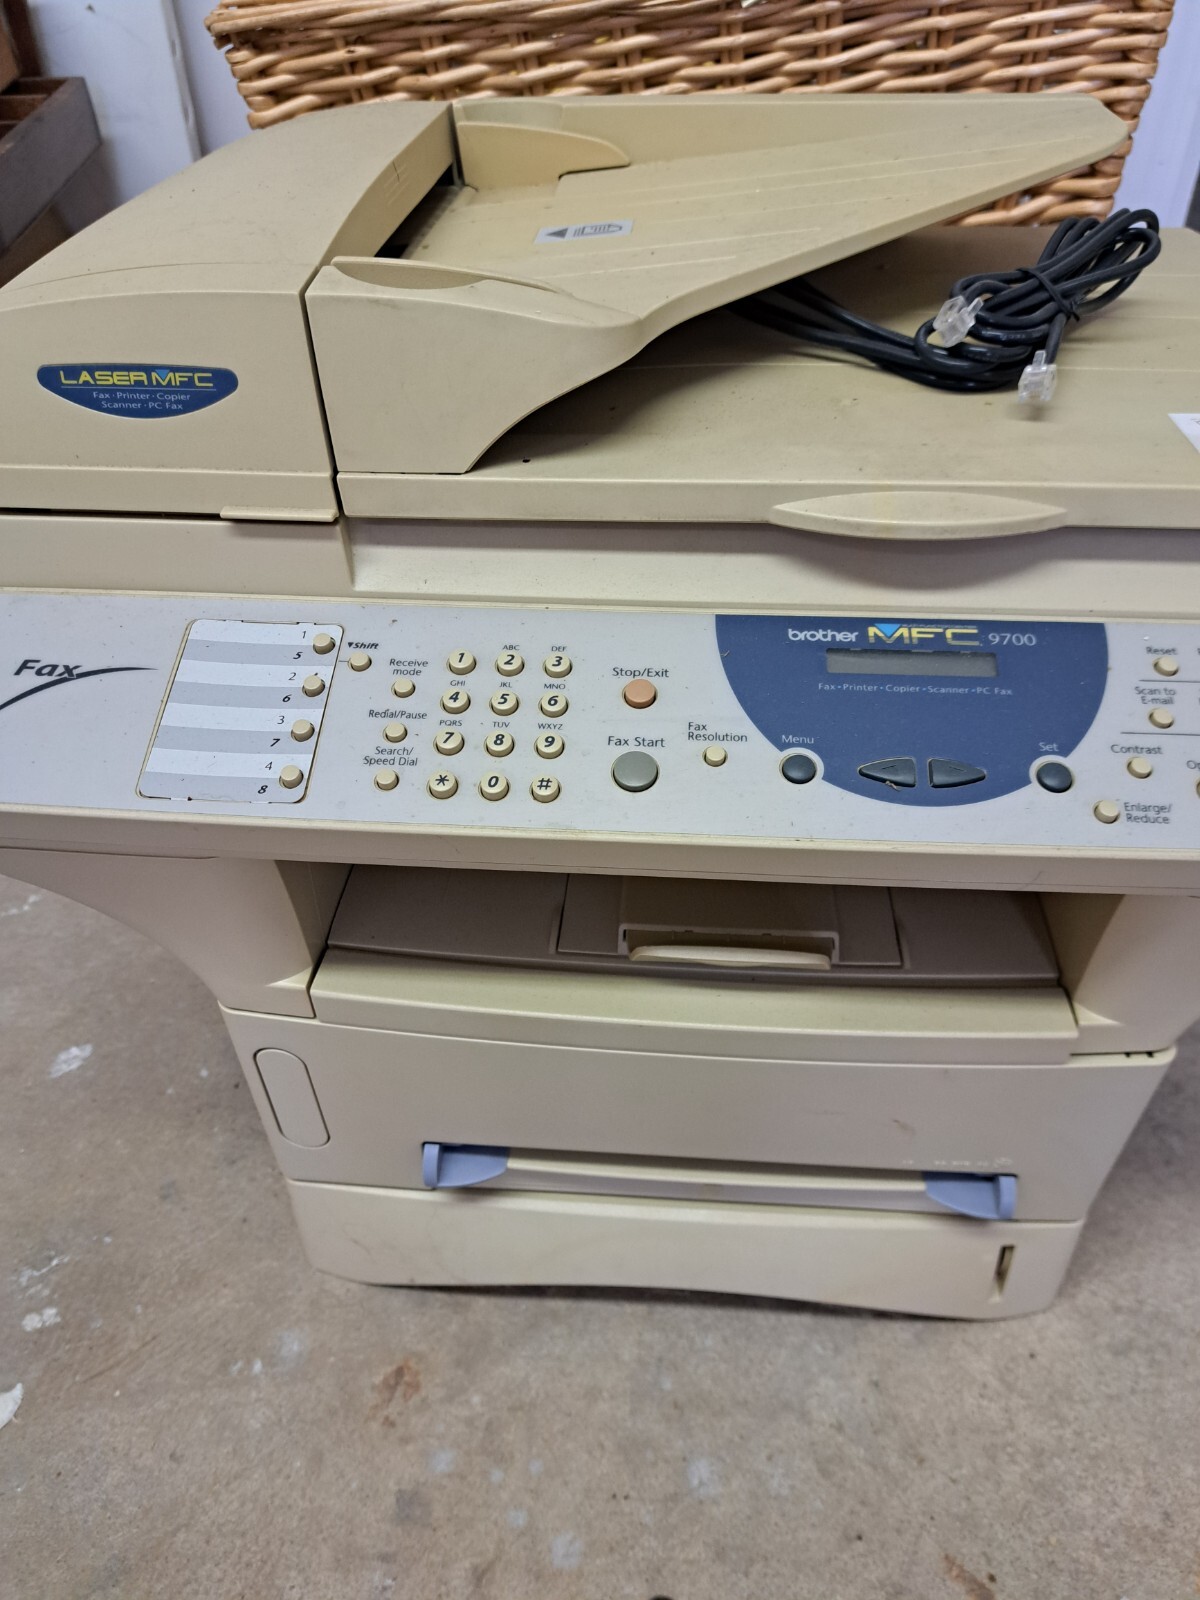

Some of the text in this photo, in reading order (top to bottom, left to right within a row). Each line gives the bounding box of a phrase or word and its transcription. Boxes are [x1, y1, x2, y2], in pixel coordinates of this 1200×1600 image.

[60, 370, 213, 387] LASER MFC
[93, 391, 191, 402] Fax Printer Copier
[101, 401, 183, 410] Scanner PC Fax
[302, 631, 307, 639] 1
[788, 624, 1037, 647] brother MFC 9700
[353, 641, 379, 650] Shift
[1145, 646, 1178, 656] Reset
[293, 651, 302, 660] 5
[456, 652, 465, 663] 1
[503, 654, 515, 665] 2
[389, 658, 429, 668] Receive
[551, 656, 563, 667] 3
[13, 658, 83, 679] Fax
[392, 668, 422, 676] mode
[612, 666, 670, 679] Stop/Exit
[288, 672, 297, 681] 2
[818, 683, 1013, 696] Fax Printer Copier Scanner PC Fax
[1134, 686, 1176, 696] Scan to
[282, 694, 291, 703] 6
[448, 691, 460, 703] 4
[498, 693, 510, 705] 5
[547, 695, 559, 707] 6
[1141, 695, 1175, 705] E-mail
[277, 715, 285, 725] 3
[368, 709, 428, 720] Redial/Pause
[439, 719, 463, 727] PQRS
[537, 723, 563, 731] WXYZ
[688, 721, 708, 731] Fax
[270, 738, 280, 748] 7
[443, 731, 454, 744] 7
[493, 733, 505, 746] 8
[544, 735, 556, 748] 9
[608, 736, 666, 748] Fax Start
[687, 732, 748, 743] Resolution
[781, 734, 814, 744] Menu
[374, 745, 414, 756] Search/
[1038, 742, 1059, 752] Set
[1110, 744, 1163, 755] Contrast
[265, 761, 273, 771] 4
[363, 756, 418, 767] Speed Dial
[488, 775, 499, 788] 0
[537, 777, 553, 791] #
[257, 785, 268, 795] 8
[1124, 801, 1173, 814] Enlarge/
[1126, 812, 1171, 824] Reduce
